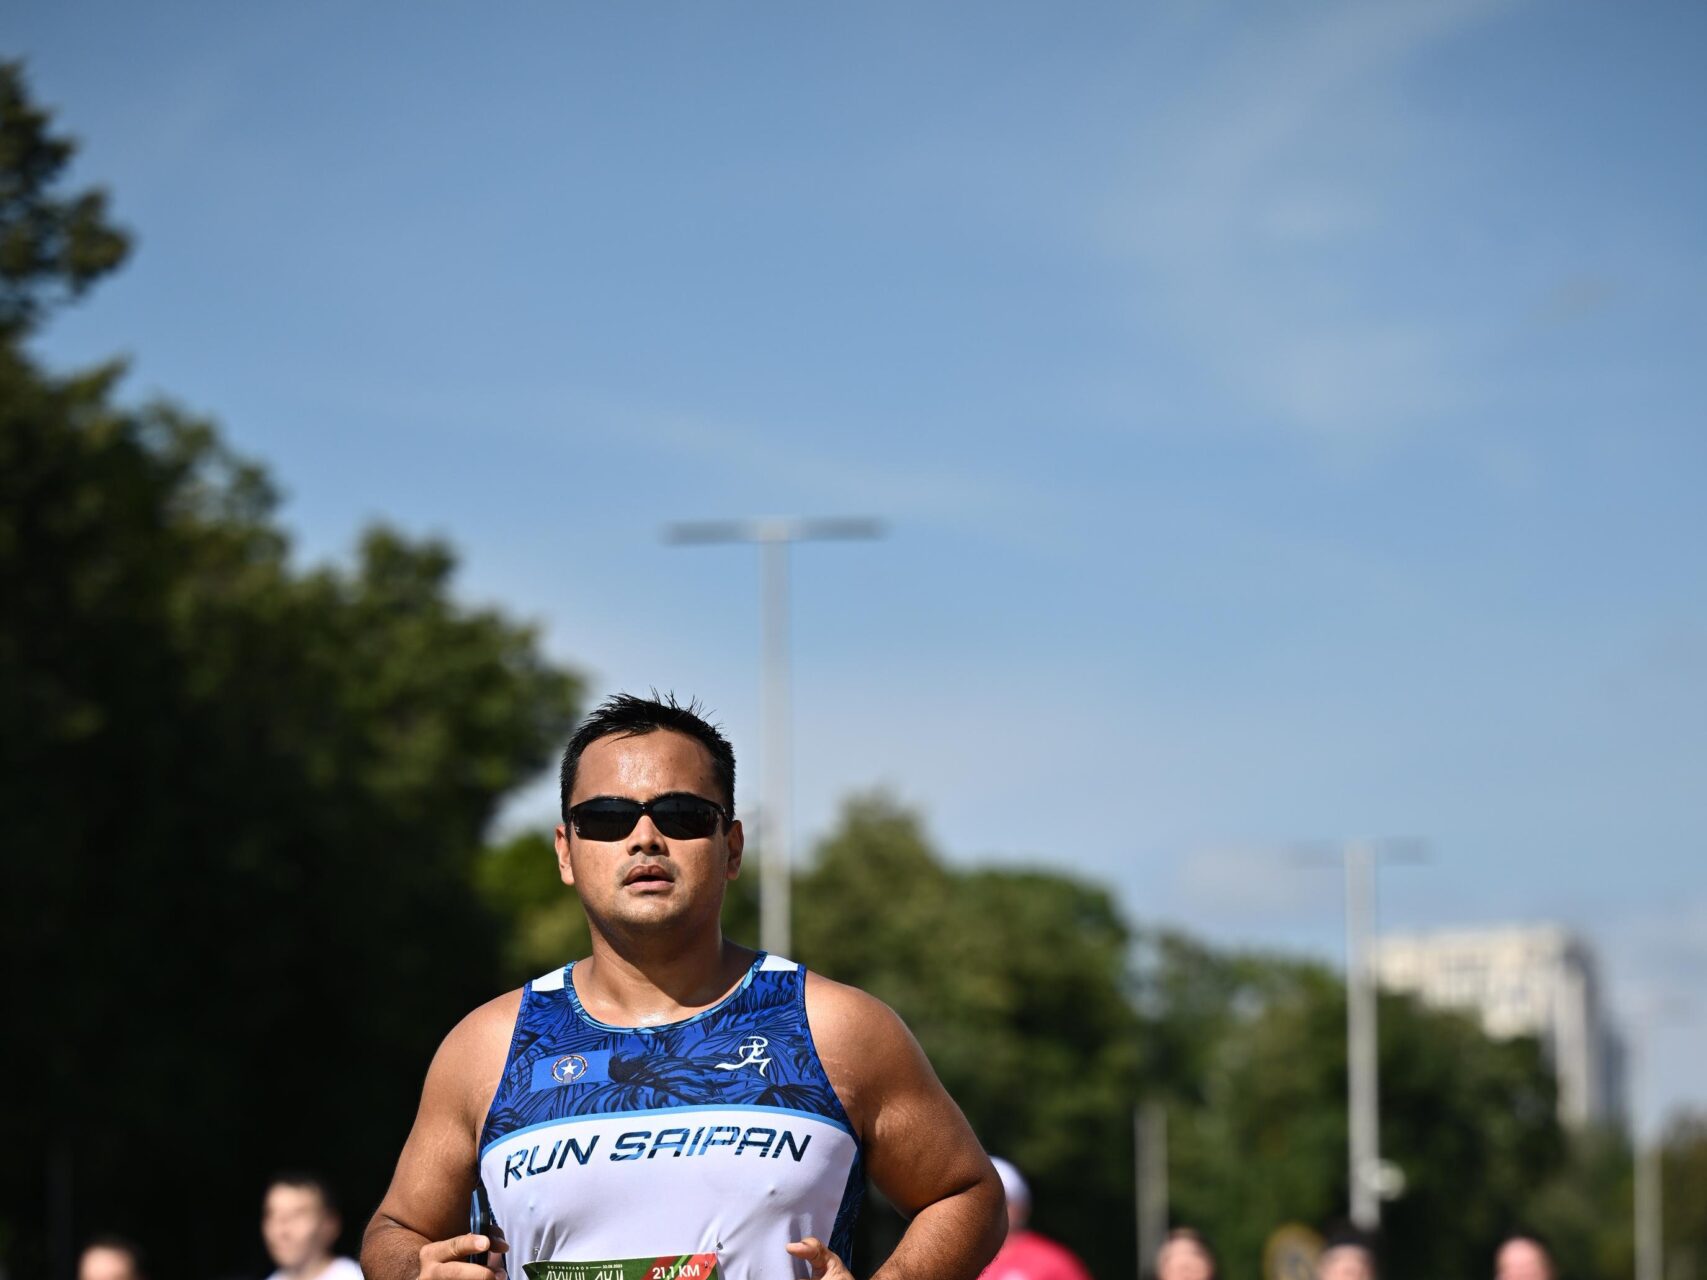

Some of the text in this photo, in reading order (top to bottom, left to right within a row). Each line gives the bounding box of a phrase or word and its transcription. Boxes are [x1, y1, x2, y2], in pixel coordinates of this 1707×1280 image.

[504, 1126, 812, 1188] RUN SAIPAN
[652, 1266, 675, 1280] 21,1
